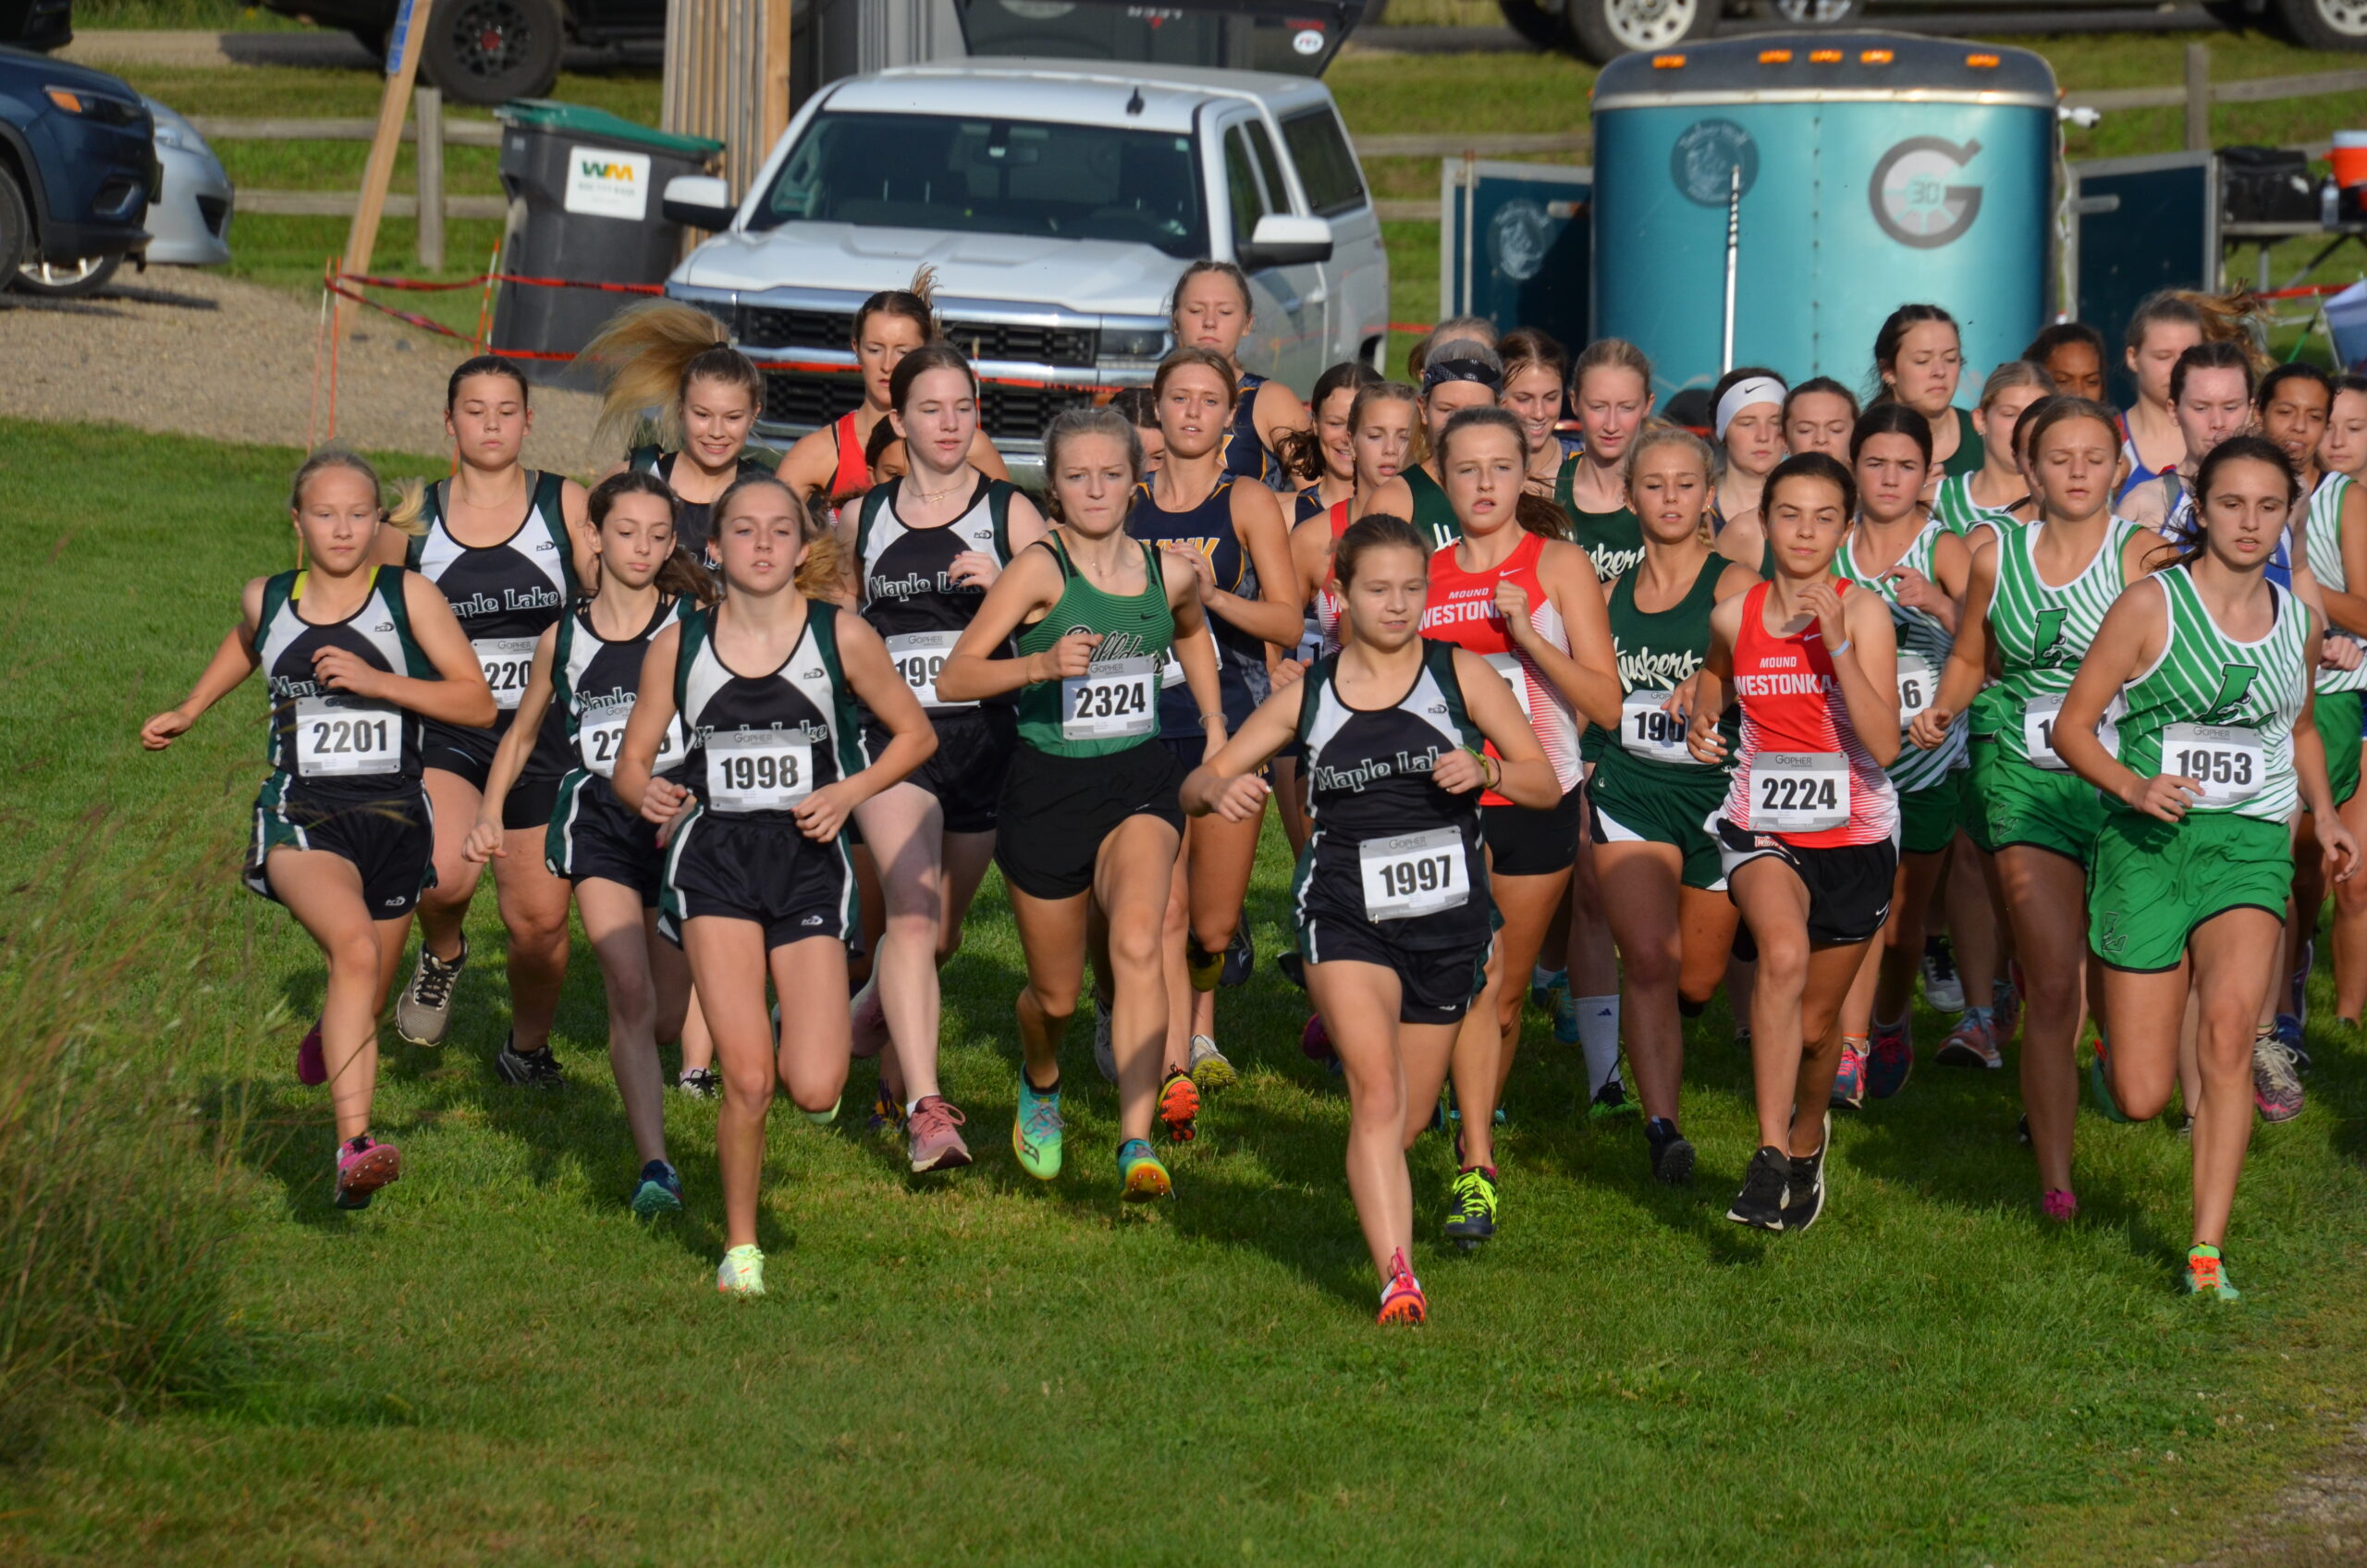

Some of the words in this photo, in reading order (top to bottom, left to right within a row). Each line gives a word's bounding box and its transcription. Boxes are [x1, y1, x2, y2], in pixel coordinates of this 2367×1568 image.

[582, 160, 634, 182] WM
[1582, 543, 1646, 582] sker
[870, 572, 931, 602] Maple
[1448, 587, 1489, 600] MOUND
[451, 593, 498, 619] aple
[504, 586, 558, 611] Lake
[1418, 598, 1500, 632] WESTON
[497, 640, 532, 649] GOPHER
[908, 635, 943, 644] GOPHER
[484, 661, 533, 691] 220
[895, 655, 945, 687] 199
[1090, 664, 1124, 673] GOPHER
[1760, 656, 1797, 668] MOUND
[270, 675, 320, 698] Map
[1734, 673, 1833, 696] WESTONKA
[607, 707, 632, 716] GOP
[1076, 682, 1146, 718] 2324
[313, 719, 387, 753] 2201
[734, 733, 773, 742] GOPHER
[1635, 711, 1686, 742] 190
[2193, 727, 2230, 738] GOPHER
[720, 755, 799, 790] 1998
[1775, 754, 1812, 765] GOPHER
[2177, 750, 2252, 785] 1953
[1316, 758, 1391, 793] Maple
[1762, 778, 1837, 810] 2224
[1389, 837, 1426, 850] GOPHER
[1379, 853, 1452, 898] 1997
